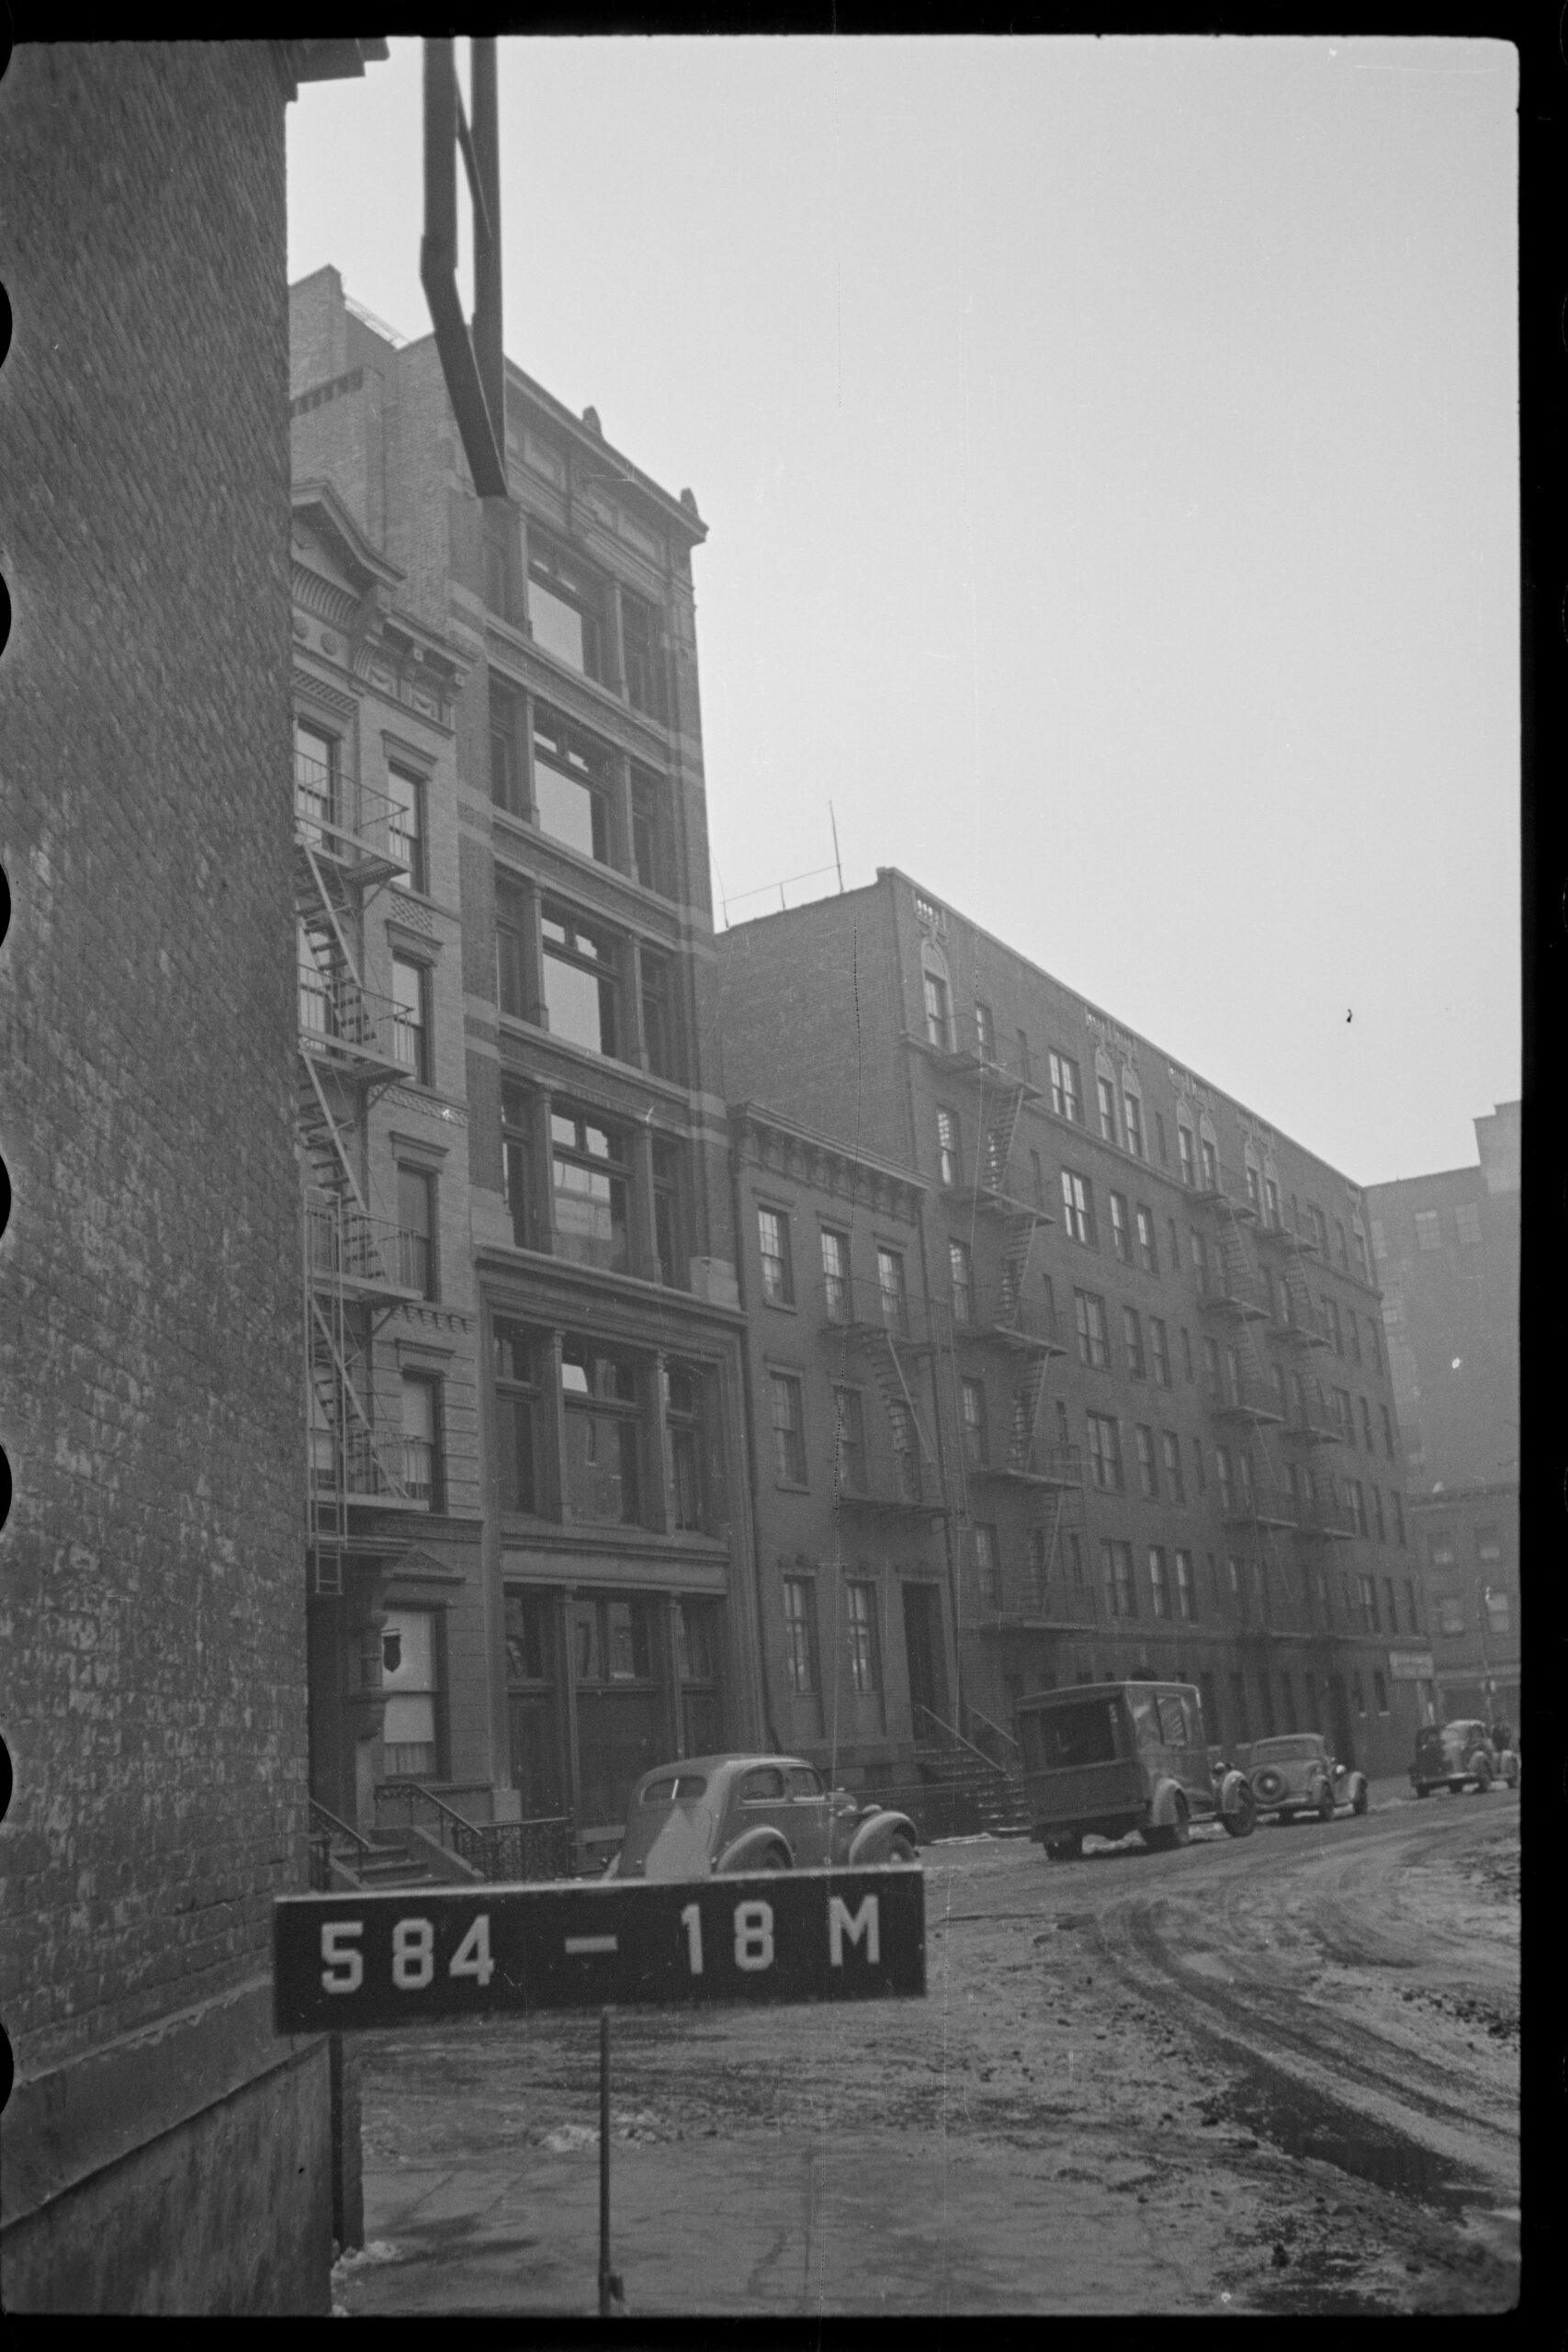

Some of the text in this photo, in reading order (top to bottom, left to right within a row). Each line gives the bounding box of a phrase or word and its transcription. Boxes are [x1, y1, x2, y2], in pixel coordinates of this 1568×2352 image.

[321, 1915, 495, 1993] 584
[680, 1902, 774, 1974] 18
[829, 1894, 880, 1967] M
